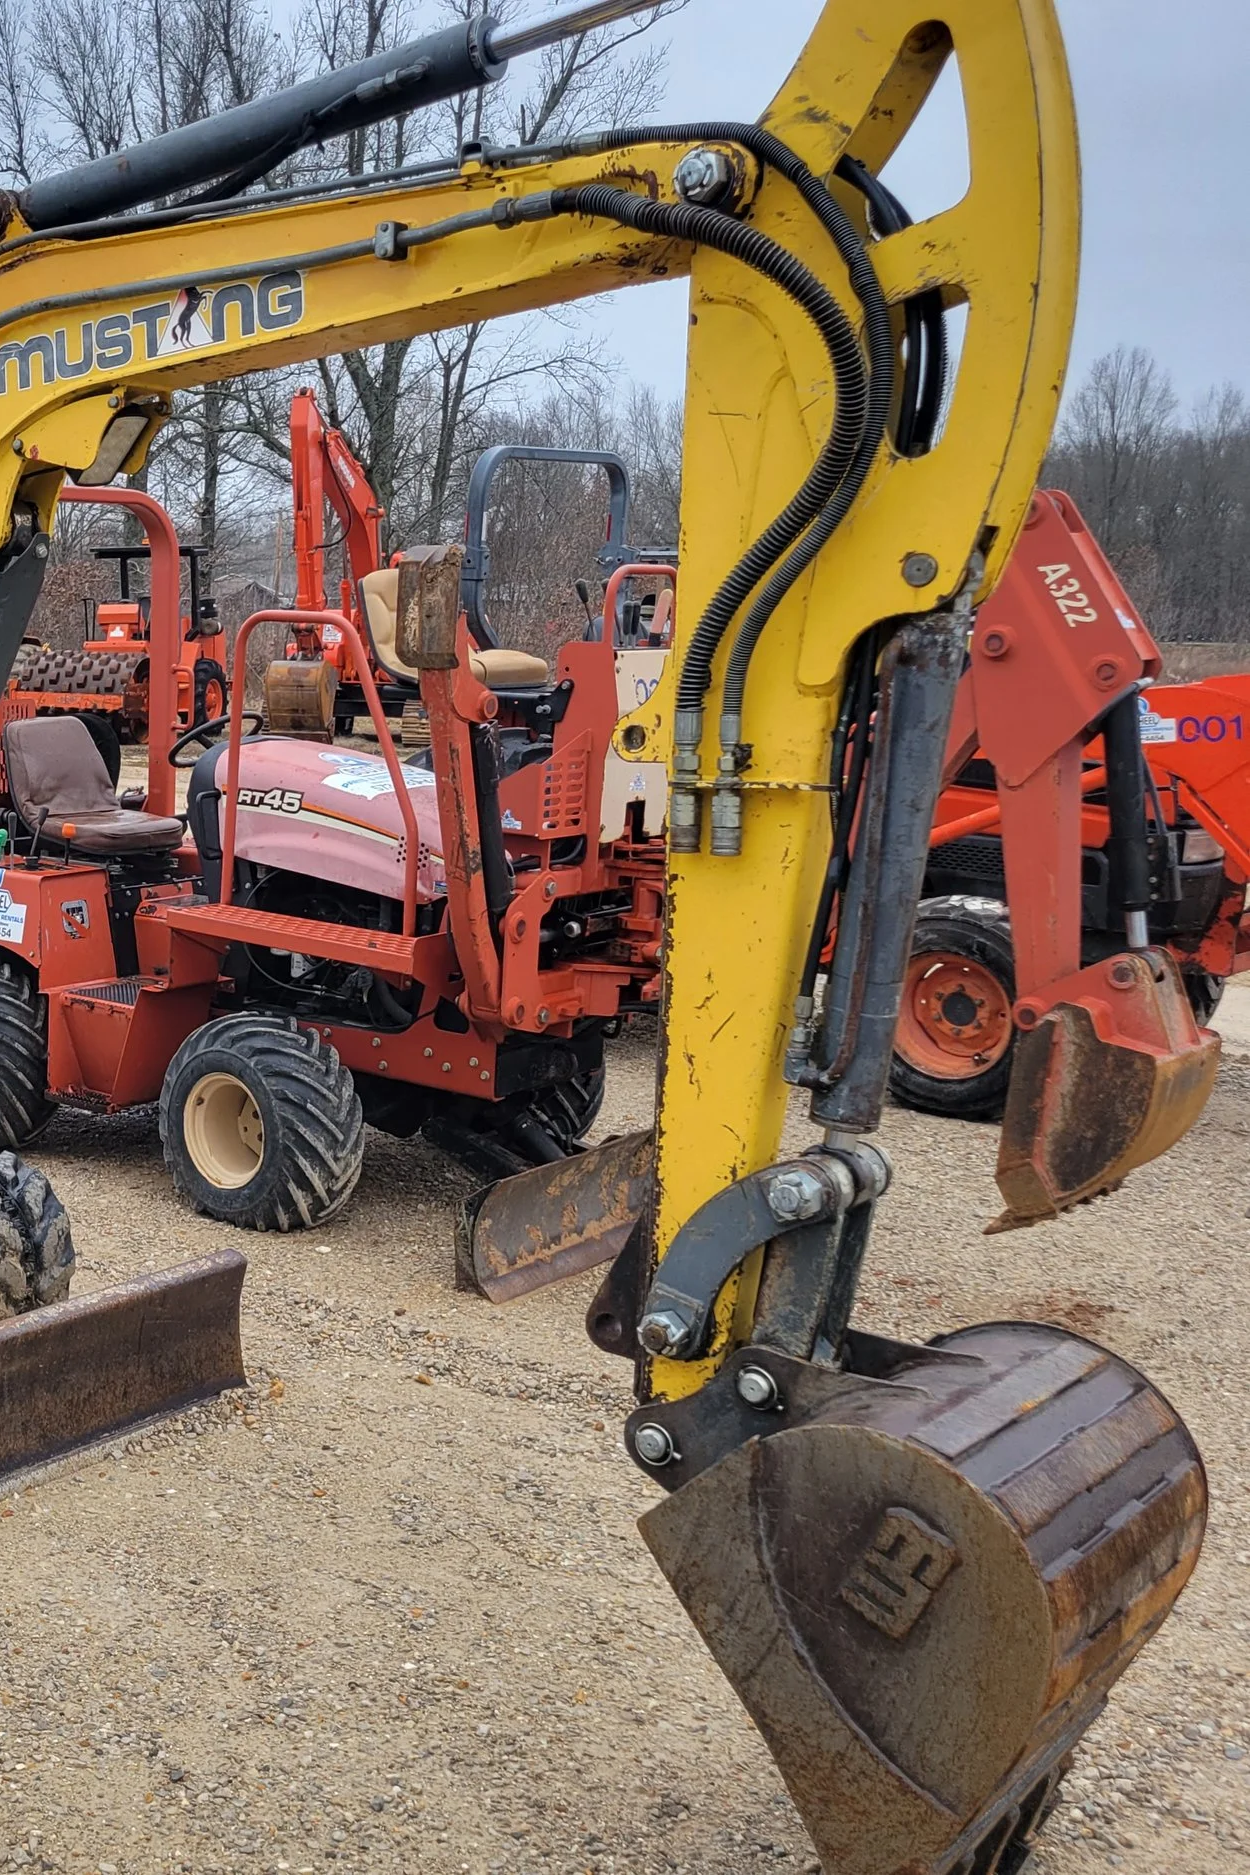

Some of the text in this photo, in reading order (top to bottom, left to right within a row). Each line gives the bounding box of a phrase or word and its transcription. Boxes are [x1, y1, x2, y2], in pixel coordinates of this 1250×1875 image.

[1037, 563, 1098, 628] A322
[238, 787, 303, 813] RT45
[1, 915, 23, 924] RENTALS
